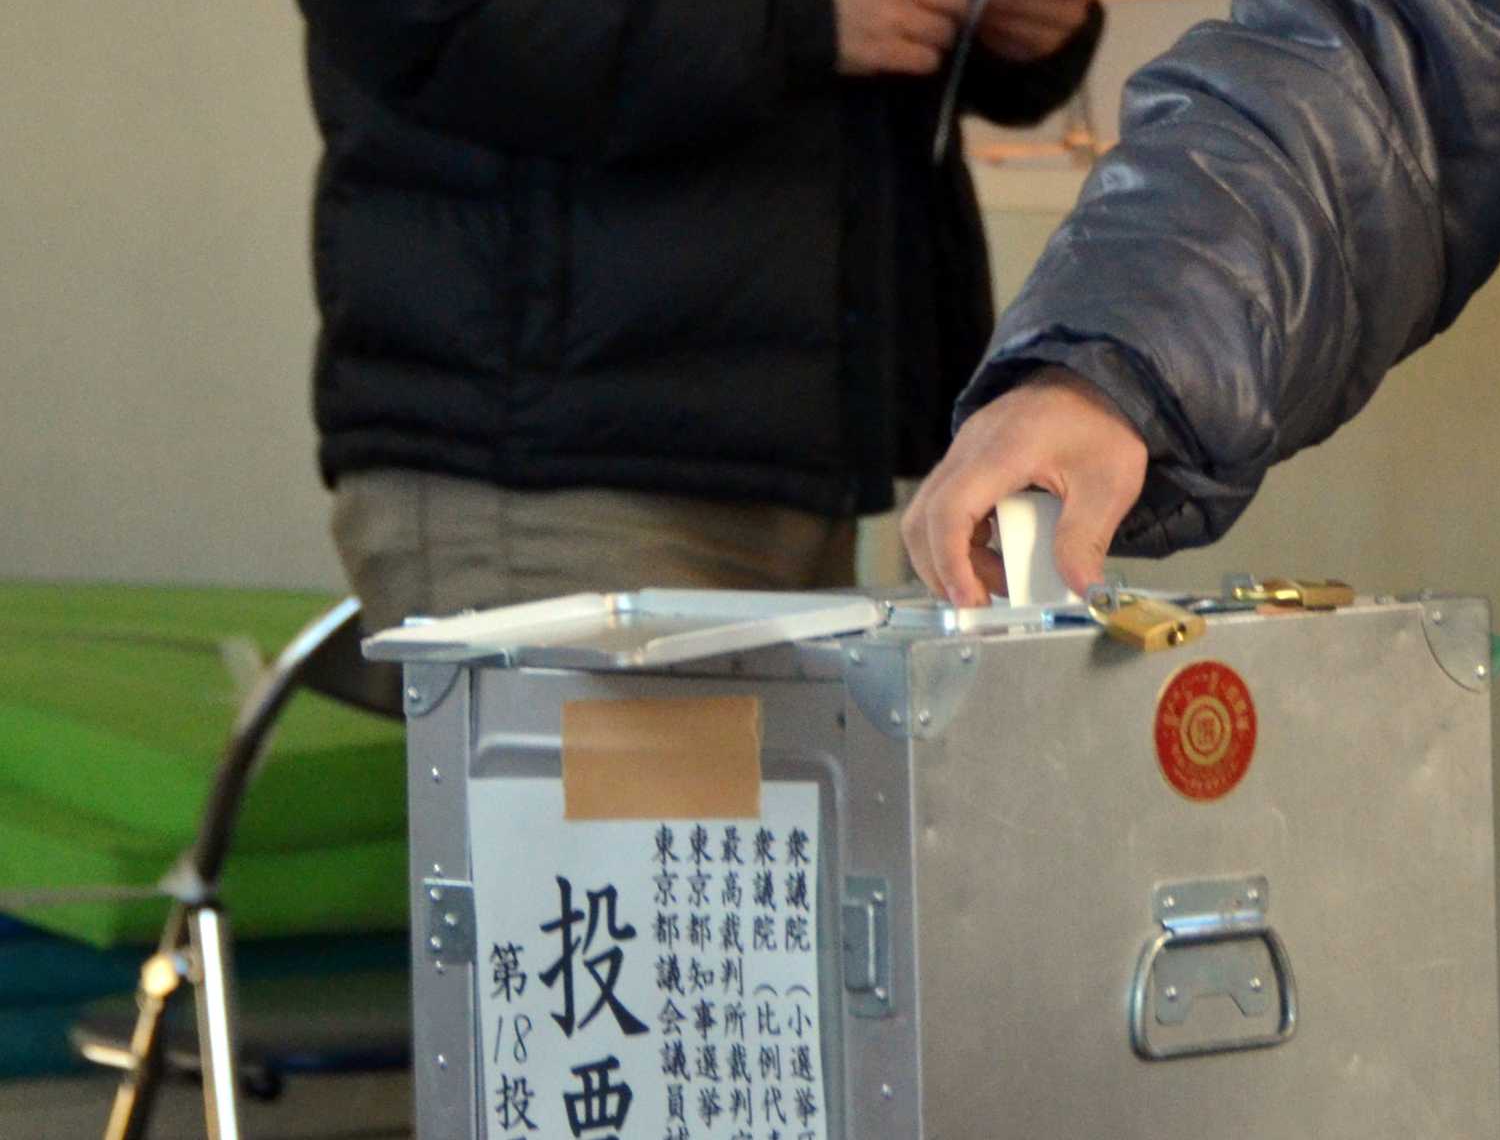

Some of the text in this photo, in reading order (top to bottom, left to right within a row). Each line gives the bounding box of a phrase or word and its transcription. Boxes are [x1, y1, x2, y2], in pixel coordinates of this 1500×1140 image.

[489, 942, 539, 1140] 第18投
[687, 822, 722, 1130] 東京都知事選挙
